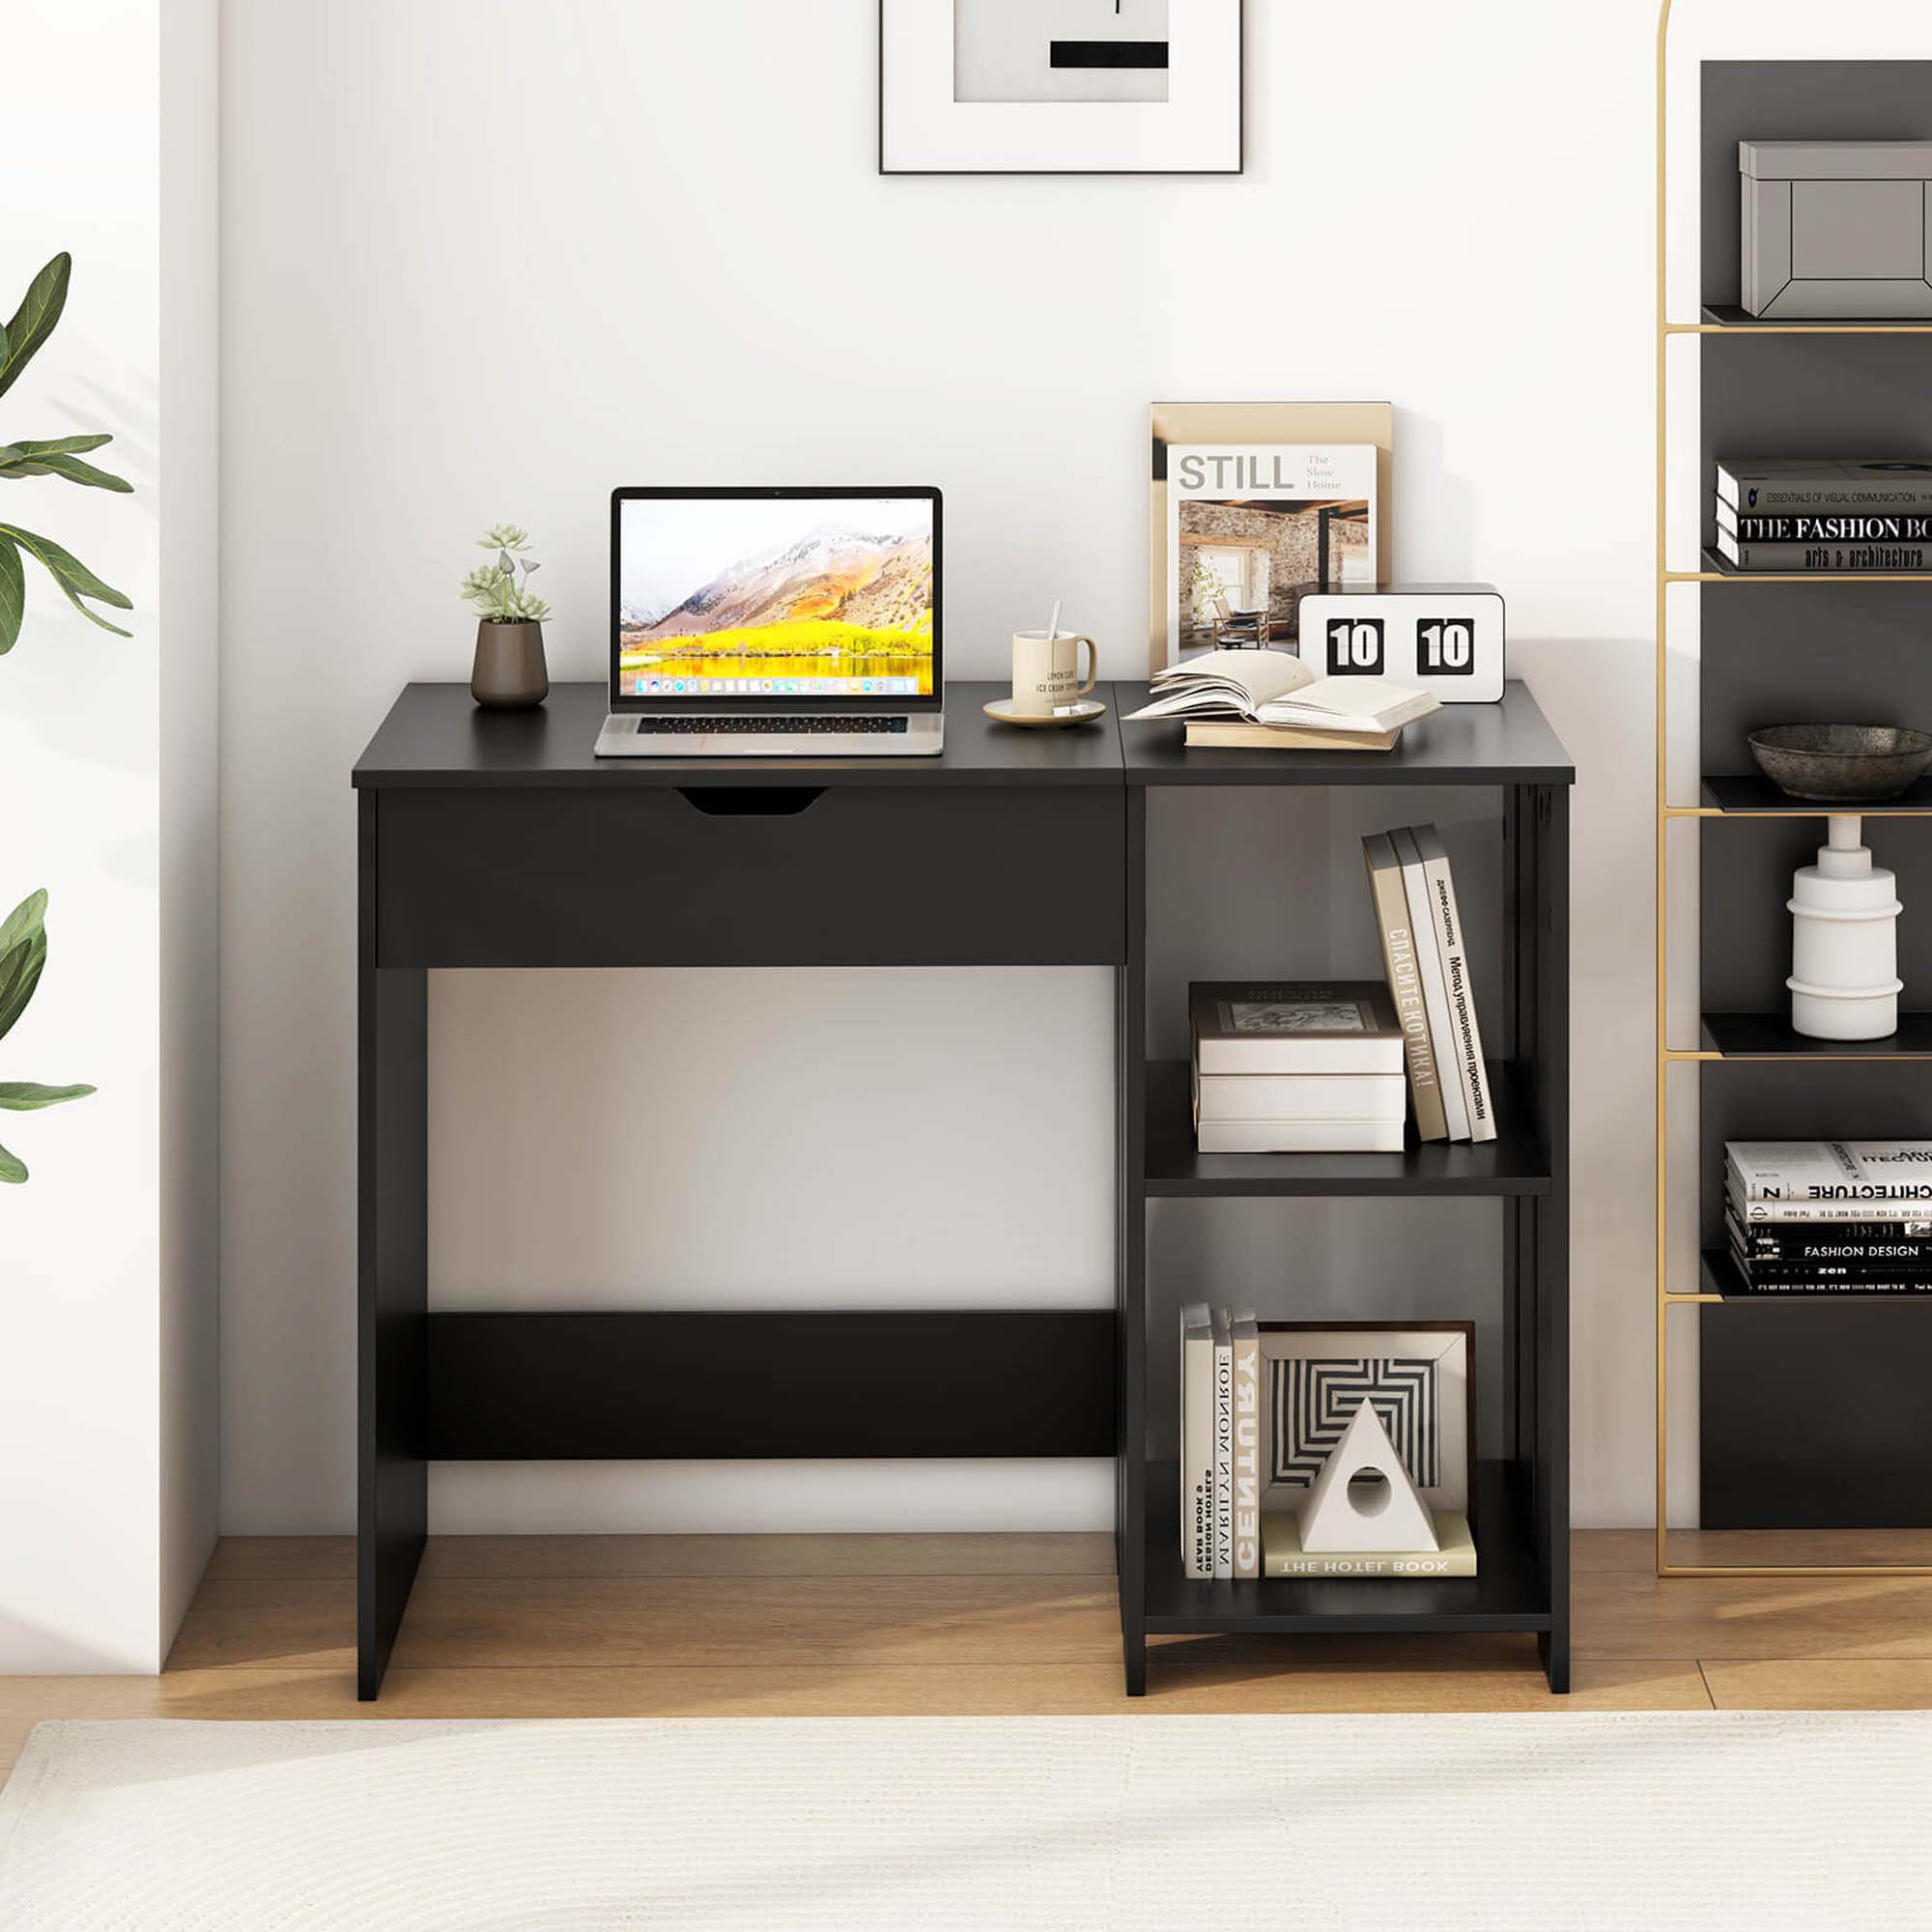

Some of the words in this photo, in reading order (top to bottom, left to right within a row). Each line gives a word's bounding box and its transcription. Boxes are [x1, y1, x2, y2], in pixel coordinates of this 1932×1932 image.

[1307, 455, 1329, 465] The
[1179, 455, 1295, 491] STILL
[1307, 469, 1334, 477] Slow
[1307, 480, 1342, 490] Home
[1766, 492, 1811, 503] ESSENTIALS
[1812, 492, 1822, 503] OF
[1741, 518, 1791, 539] THE
[1796, 517, 1900, 539] FASHION
[1805, 547, 1830, 567] arts
[1849, 545, 1923, 567] architecture
[1330, 624, 1378, 667] 10
[1421, 624, 1469, 668] 10
[1390, 928, 1420, 1007] СПАСИТЕ
[1404, 1009, 1435, 1088] КОТИКА!
[1449, 956, 1463, 994] Метод
[1466, 1061, 1486, 1121] проектами
[1808, 1184, 1932, 1199] CHITECTURE
[1804, 1245, 1864, 1258] FASHION
[1868, 1245, 1918, 1258] DESIGN
